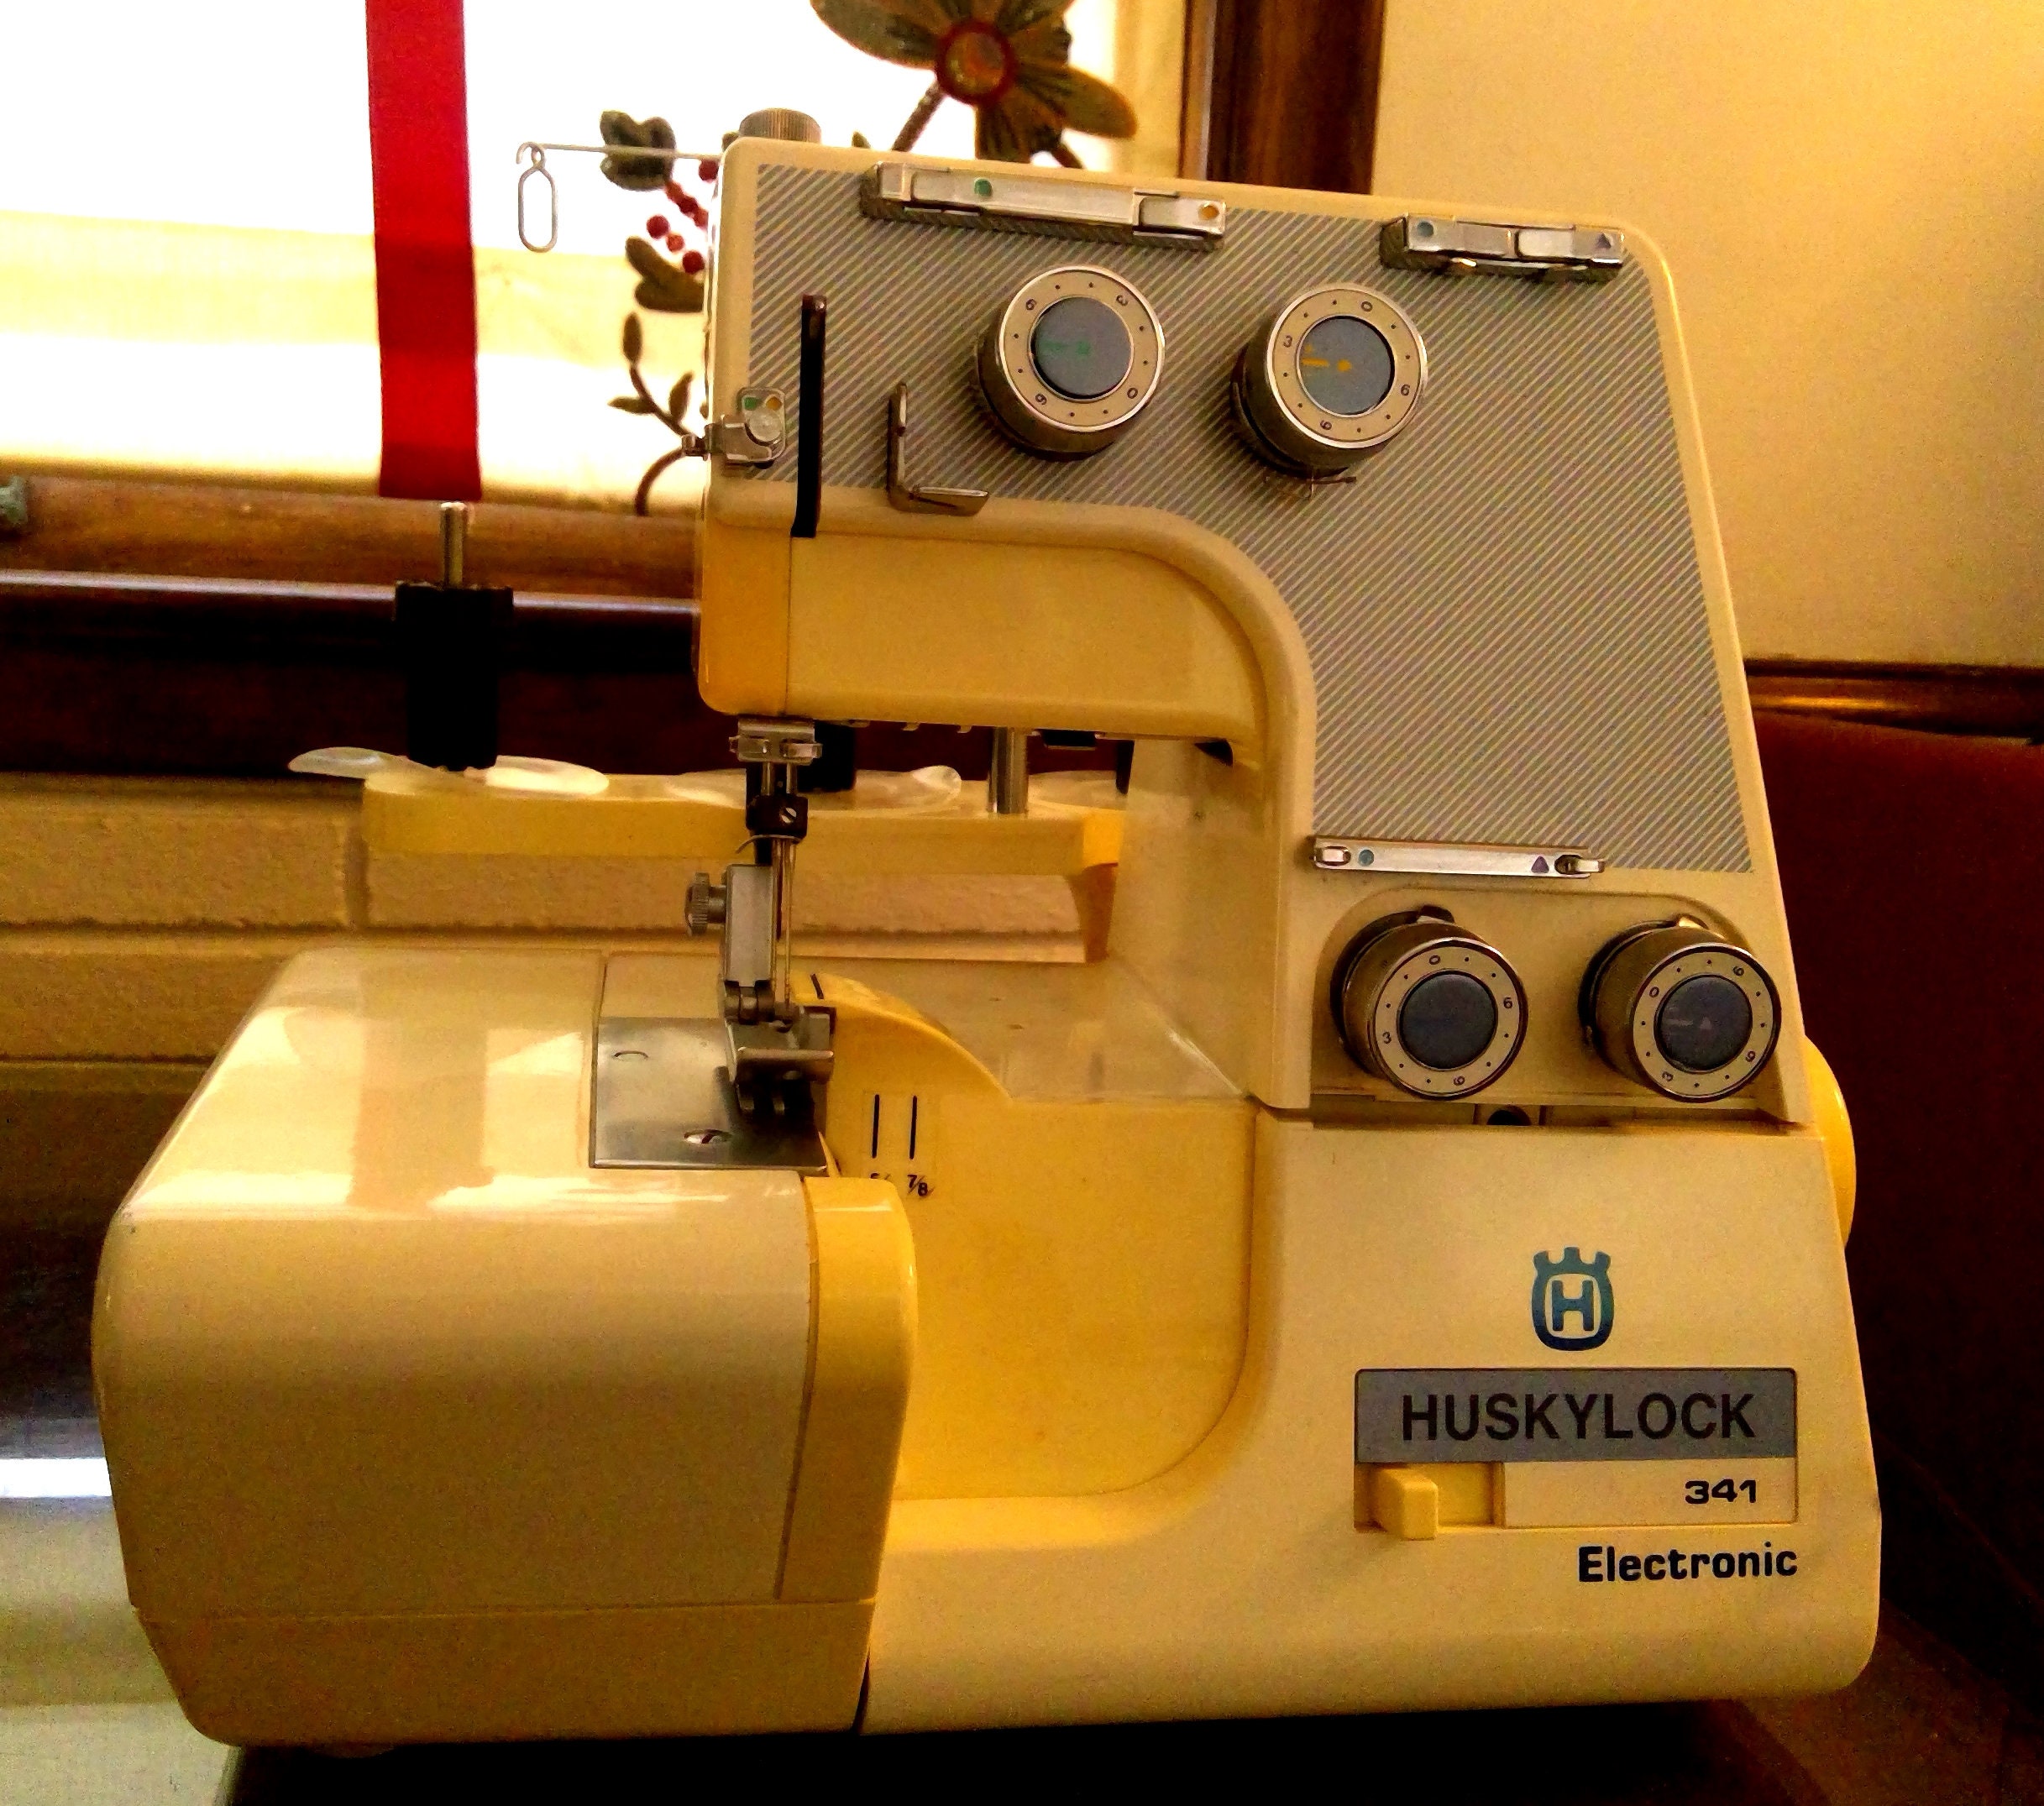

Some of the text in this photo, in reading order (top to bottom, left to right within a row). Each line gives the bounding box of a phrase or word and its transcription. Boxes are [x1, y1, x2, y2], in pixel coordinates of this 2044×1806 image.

[1283, 335, 1293, 348] 3
[1382, 1031, 1392, 1044] 3
[1402, 1393, 1757, 1442] HUSKYLOCK
[1684, 1478, 1758, 1505] 341
[1577, 1542, 1798, 1583] Electronic
